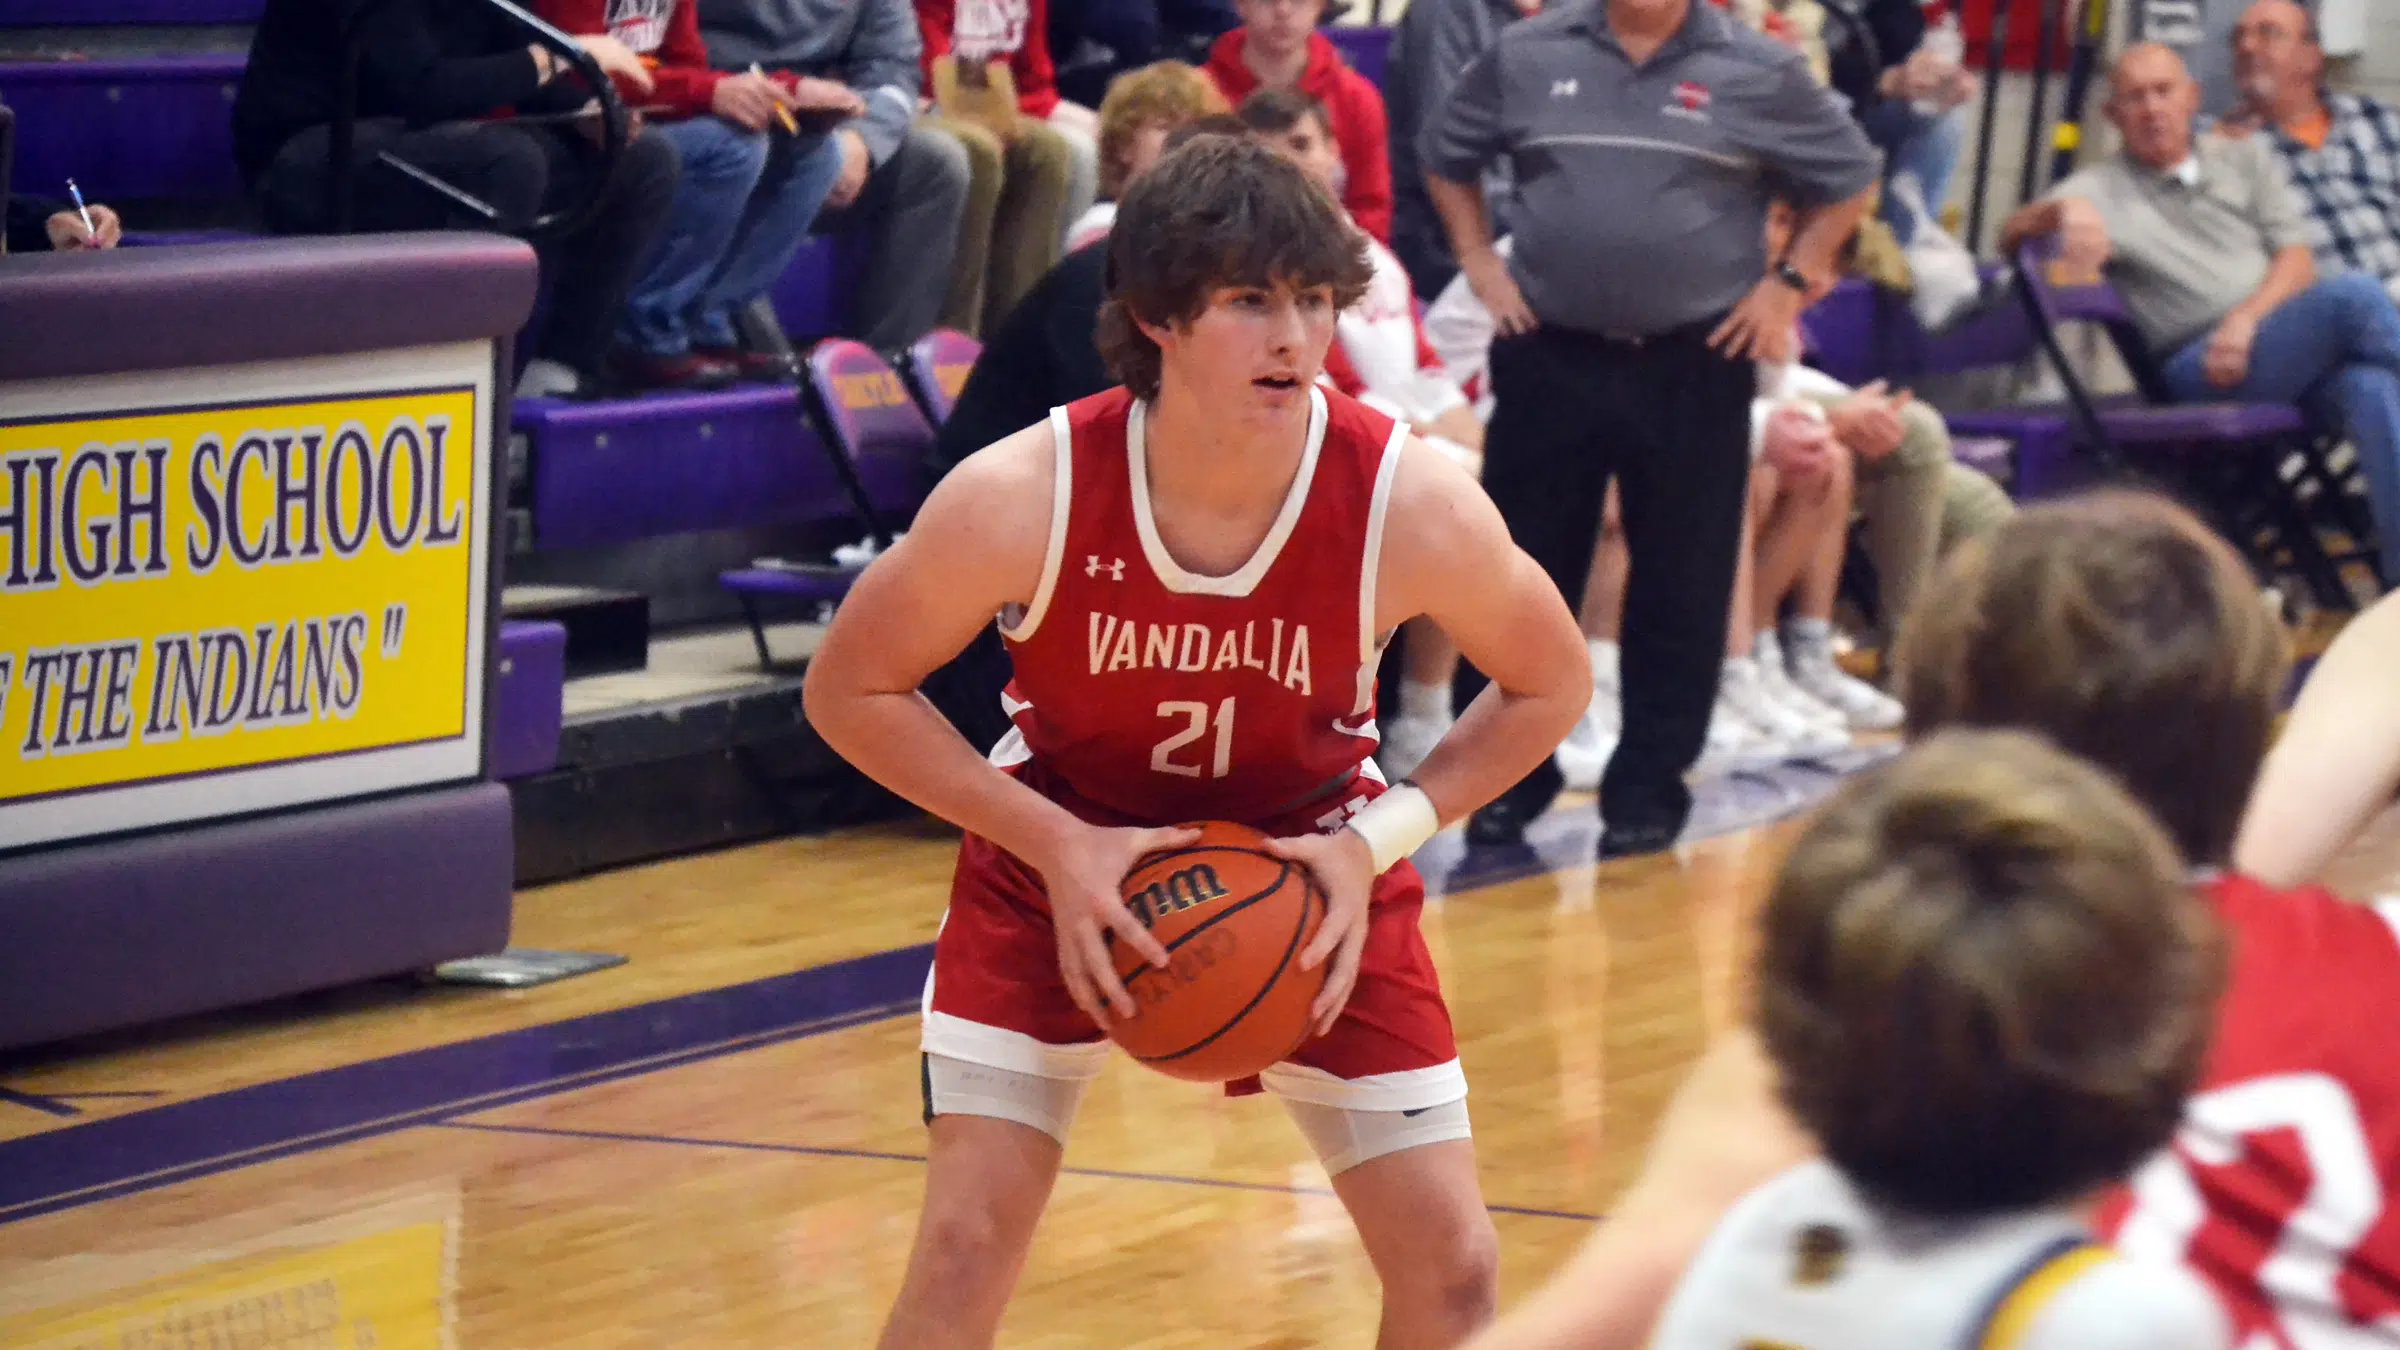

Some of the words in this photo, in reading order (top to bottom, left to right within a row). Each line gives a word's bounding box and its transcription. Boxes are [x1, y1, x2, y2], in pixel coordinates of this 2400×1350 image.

[0, 446, 168, 587] HIGH
[187, 424, 461, 570] SCHOOL
[22, 643, 138, 753] THE
[143, 615, 365, 737] INDIANS
[1088, 611, 1313, 697] VANDALIA
[1149, 695, 1237, 779] 21
[1126, 862, 1231, 931] Wil
